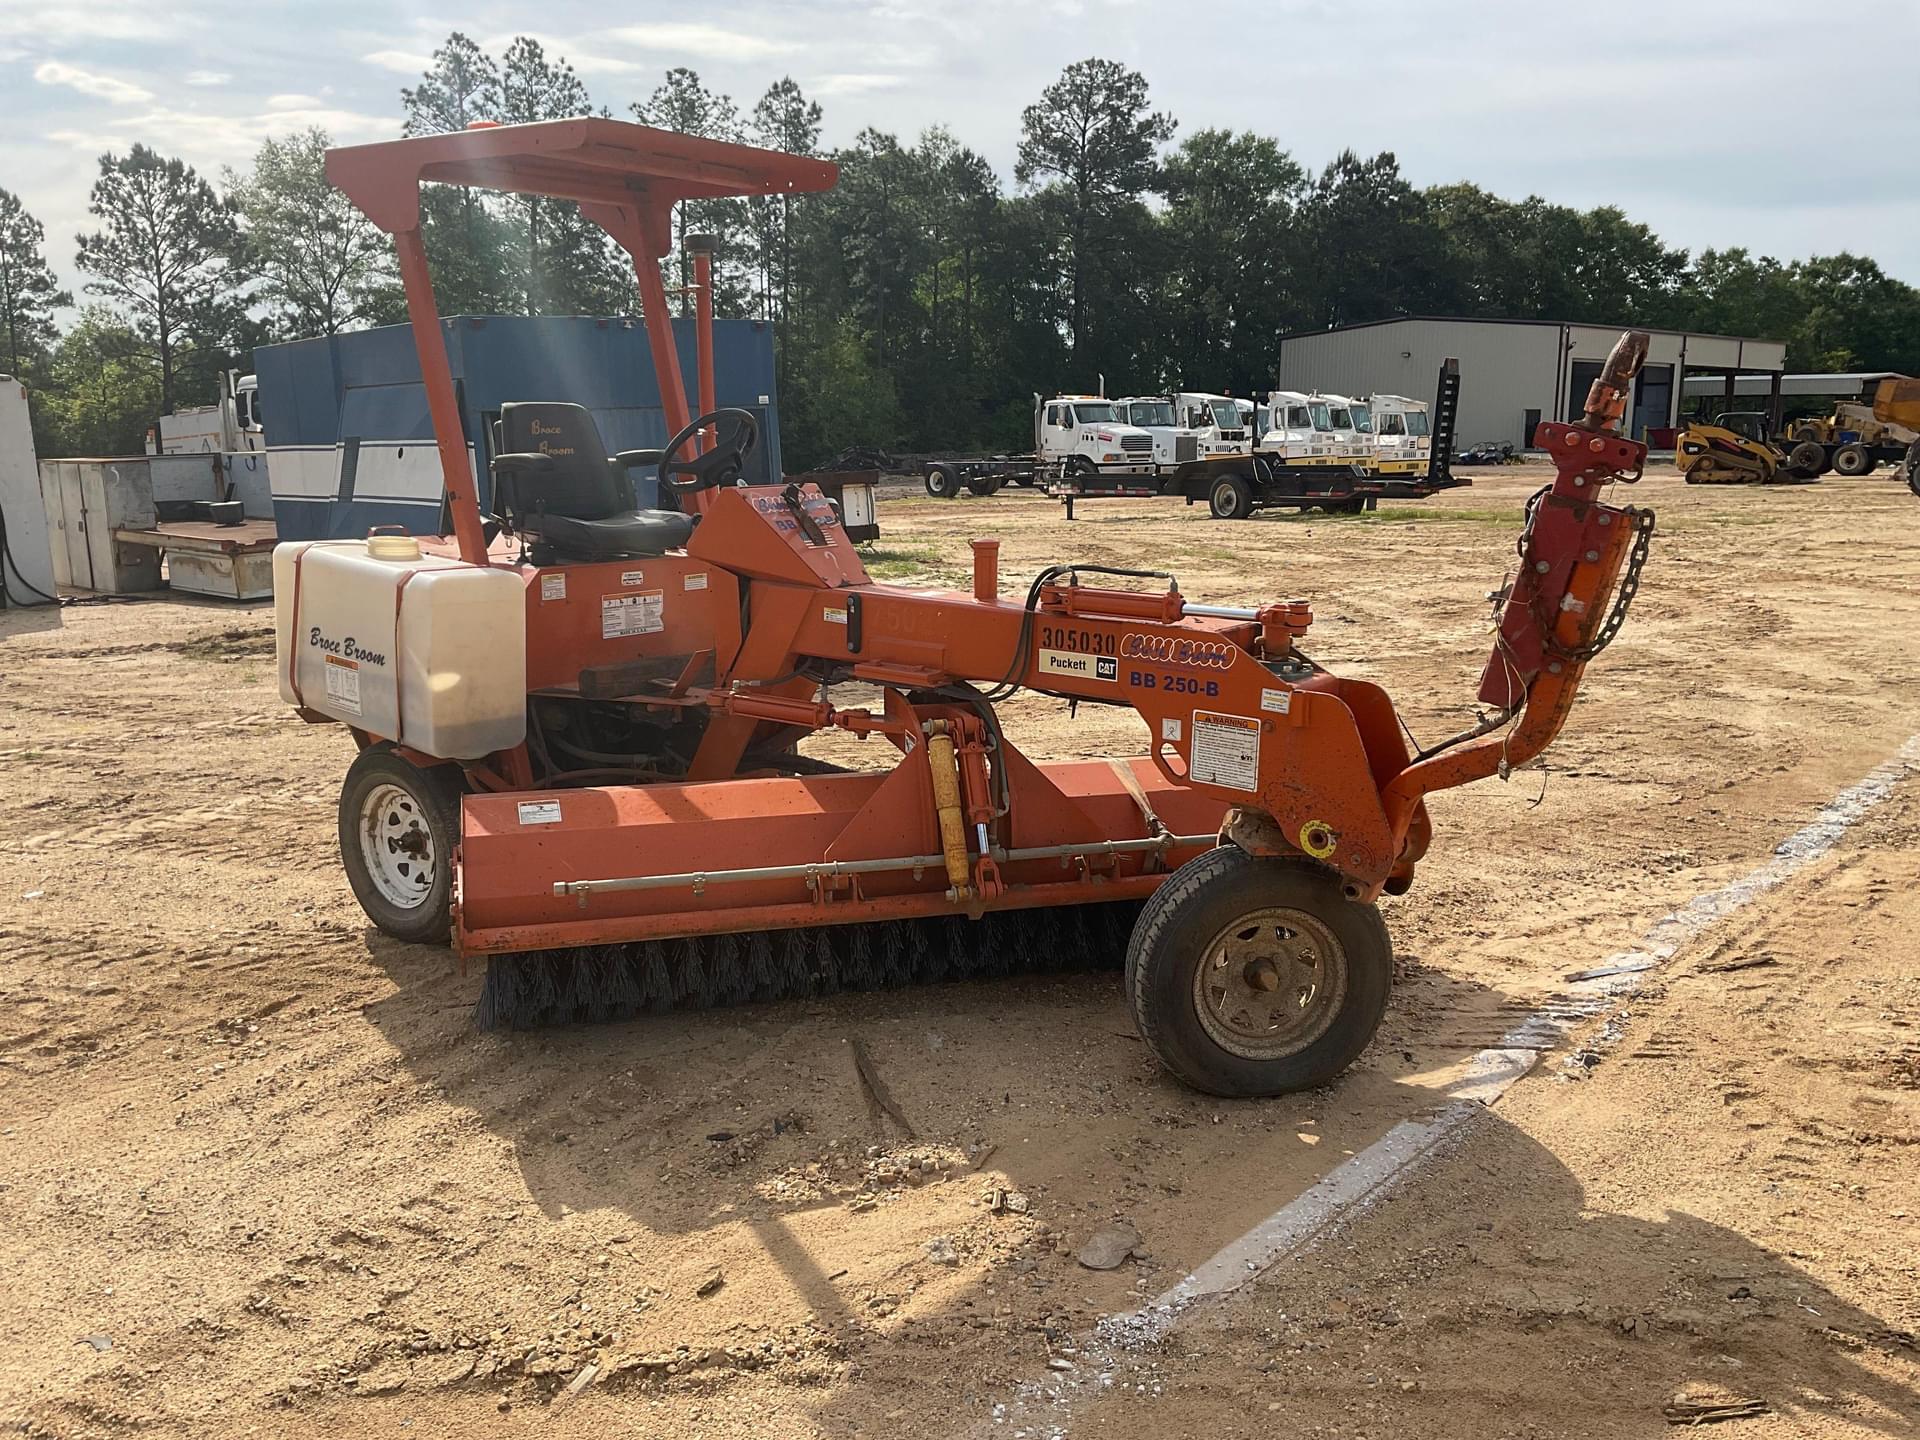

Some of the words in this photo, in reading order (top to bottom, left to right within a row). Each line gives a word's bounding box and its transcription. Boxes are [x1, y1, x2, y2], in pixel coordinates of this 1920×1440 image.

[776, 519, 797, 530] BB
[310, 627, 341, 653] Broce
[343, 637, 386, 666] Broom
[1043, 627, 1116, 655] 305030
[1050, 656, 1087, 671] Puckett
[1098, 662, 1116, 675] CAT
[1130, 672, 1156, 689] BB
[1163, 676, 1219, 697] 250-B
[1213, 716, 1249, 728] WARNING
